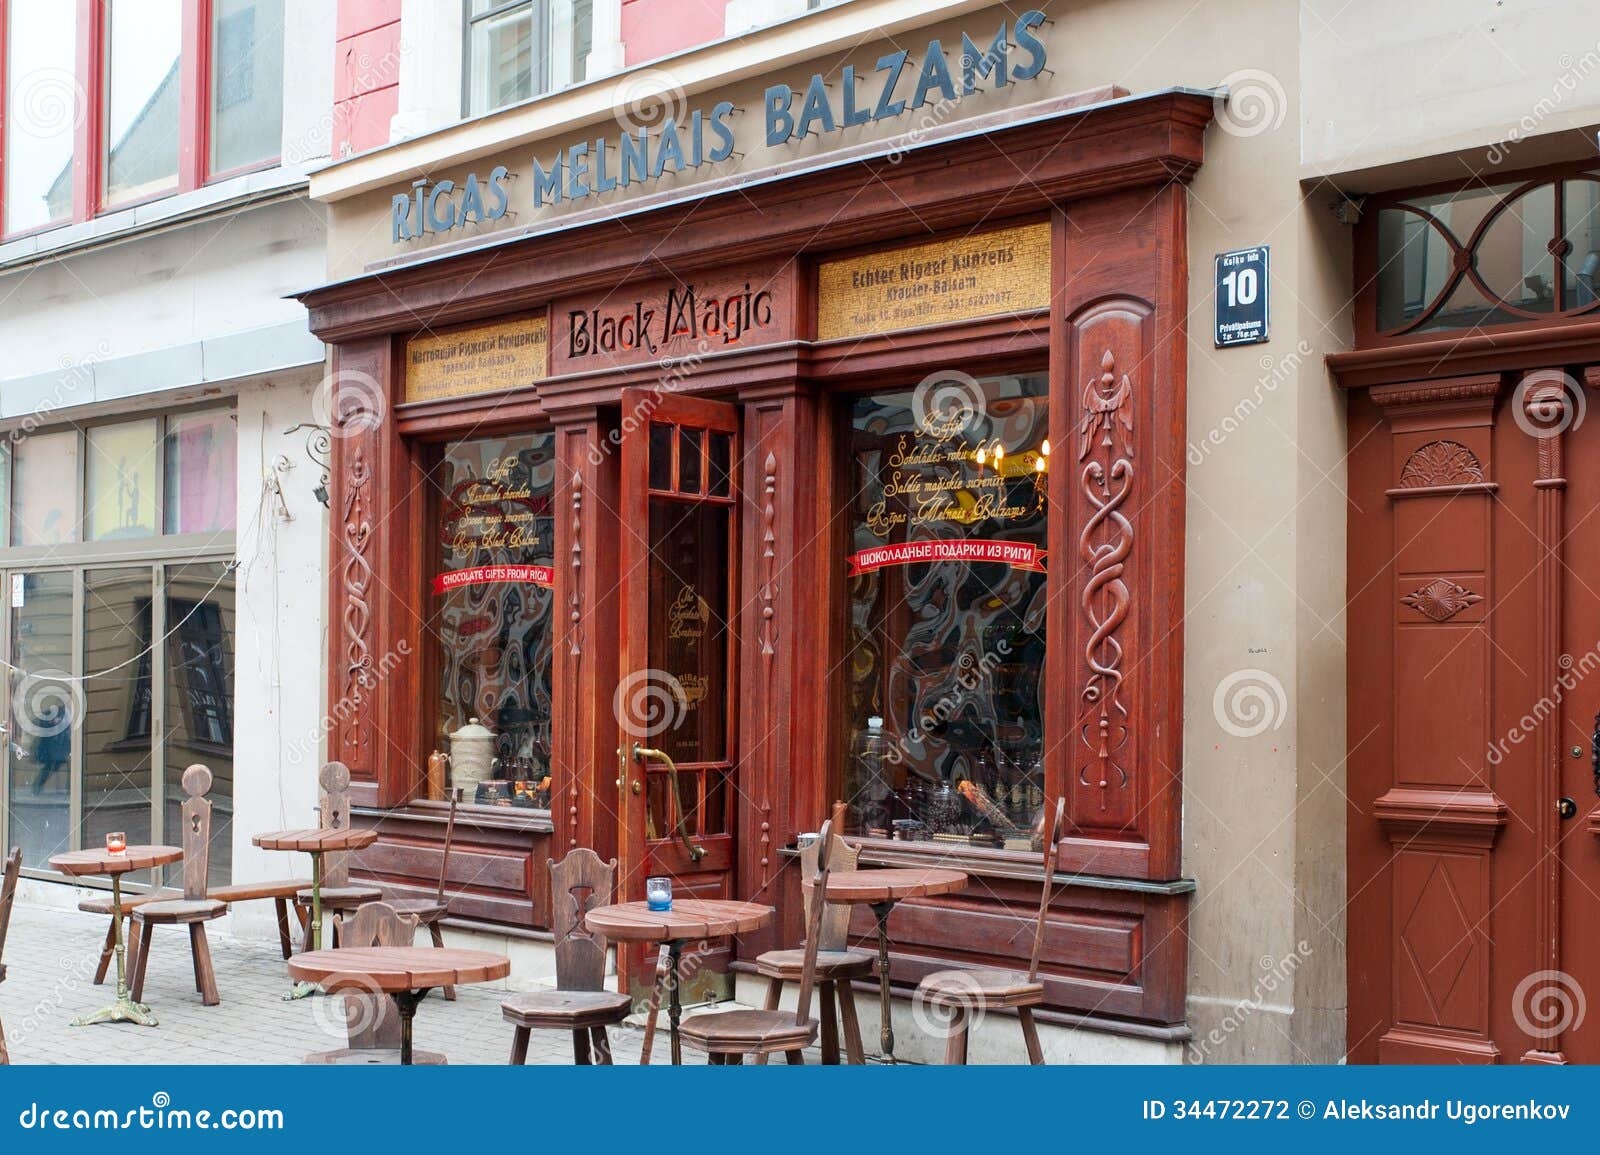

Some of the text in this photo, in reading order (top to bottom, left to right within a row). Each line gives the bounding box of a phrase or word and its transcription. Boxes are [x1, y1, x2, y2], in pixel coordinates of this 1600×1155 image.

[392, 10, 1047, 244] RĪGAS MELNAIS BALZAMS
[1222, 268, 1258, 307] 10
[568, 283, 773, 358] Black Magic
[859, 543, 1032, 567] ШОКОЛАДНЫЕ ПОДАРКИ ИЗ РИГИ
[443, 568, 548, 585] CHOCOLATE GIFTS FROM RIGA
